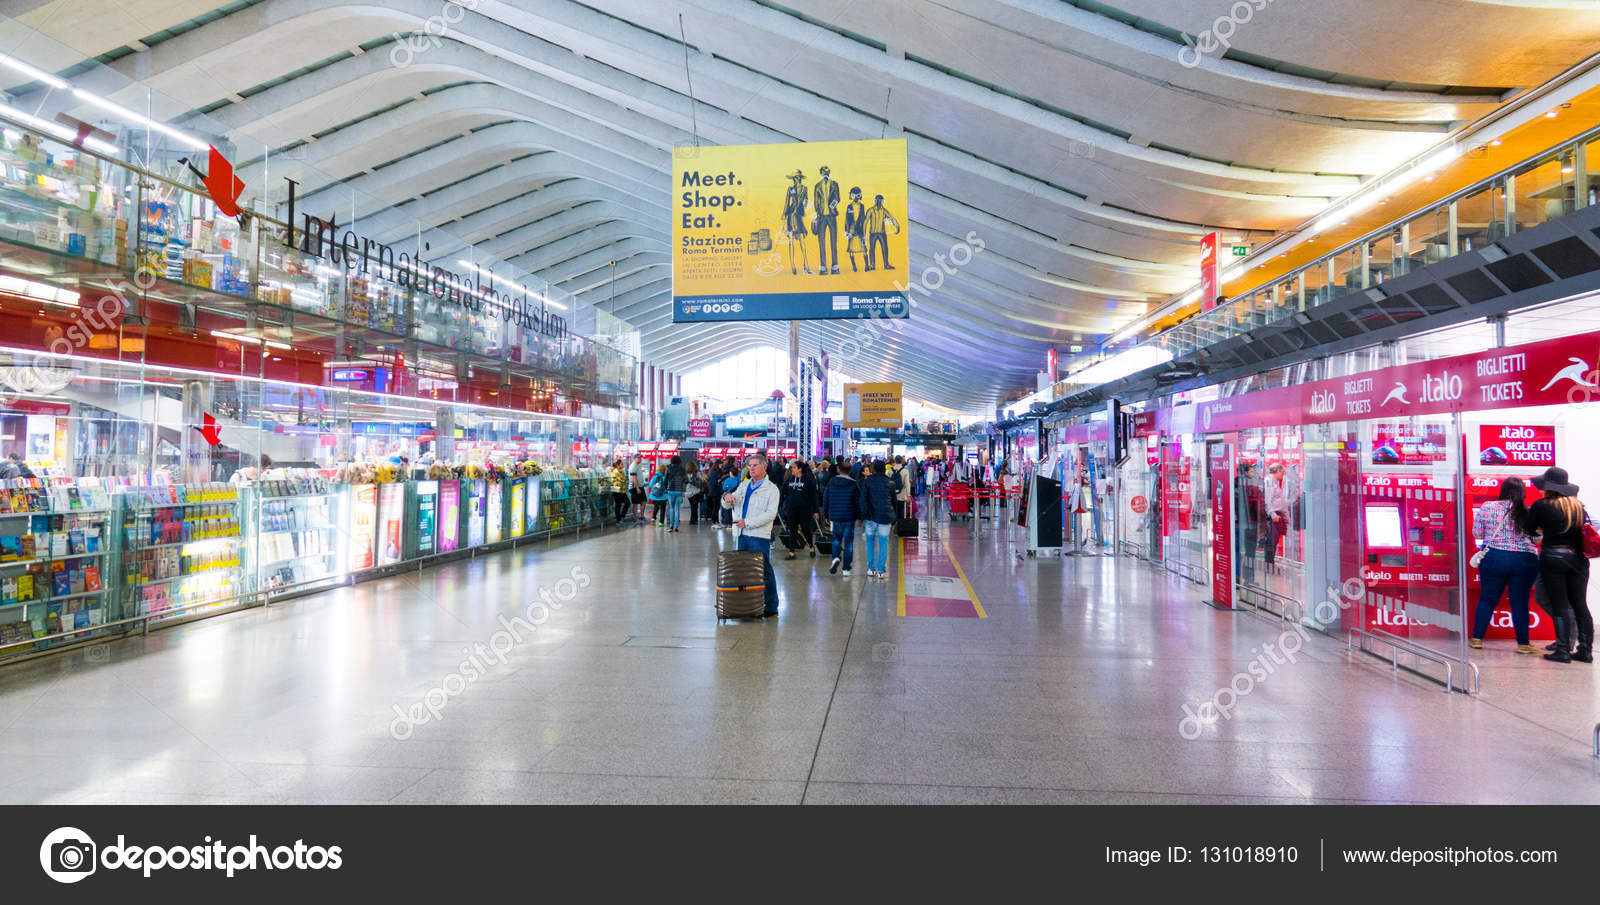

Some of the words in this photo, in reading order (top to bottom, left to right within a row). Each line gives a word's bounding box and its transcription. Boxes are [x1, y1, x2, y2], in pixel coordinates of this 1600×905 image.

[682, 171, 742, 188] Meet.
[682, 191, 742, 211] Shop.
[682, 213, 721, 229] Eat.
[682, 234, 743, 247] Stazione
[711, 246, 743, 254] Termini
[282, 176, 481, 312] International
[486, 265, 568, 355] bookshop
[1477, 353, 1526, 377] BIGLIETTI
[1344, 378, 1373, 395] BIGLIETTI
[1480, 381, 1524, 402] TICKETS
[1346, 399, 1371, 415] TICKETS
[1505, 442, 1552, 451] BIGLIETTI
[1511, 451, 1552, 461] TICKETS
